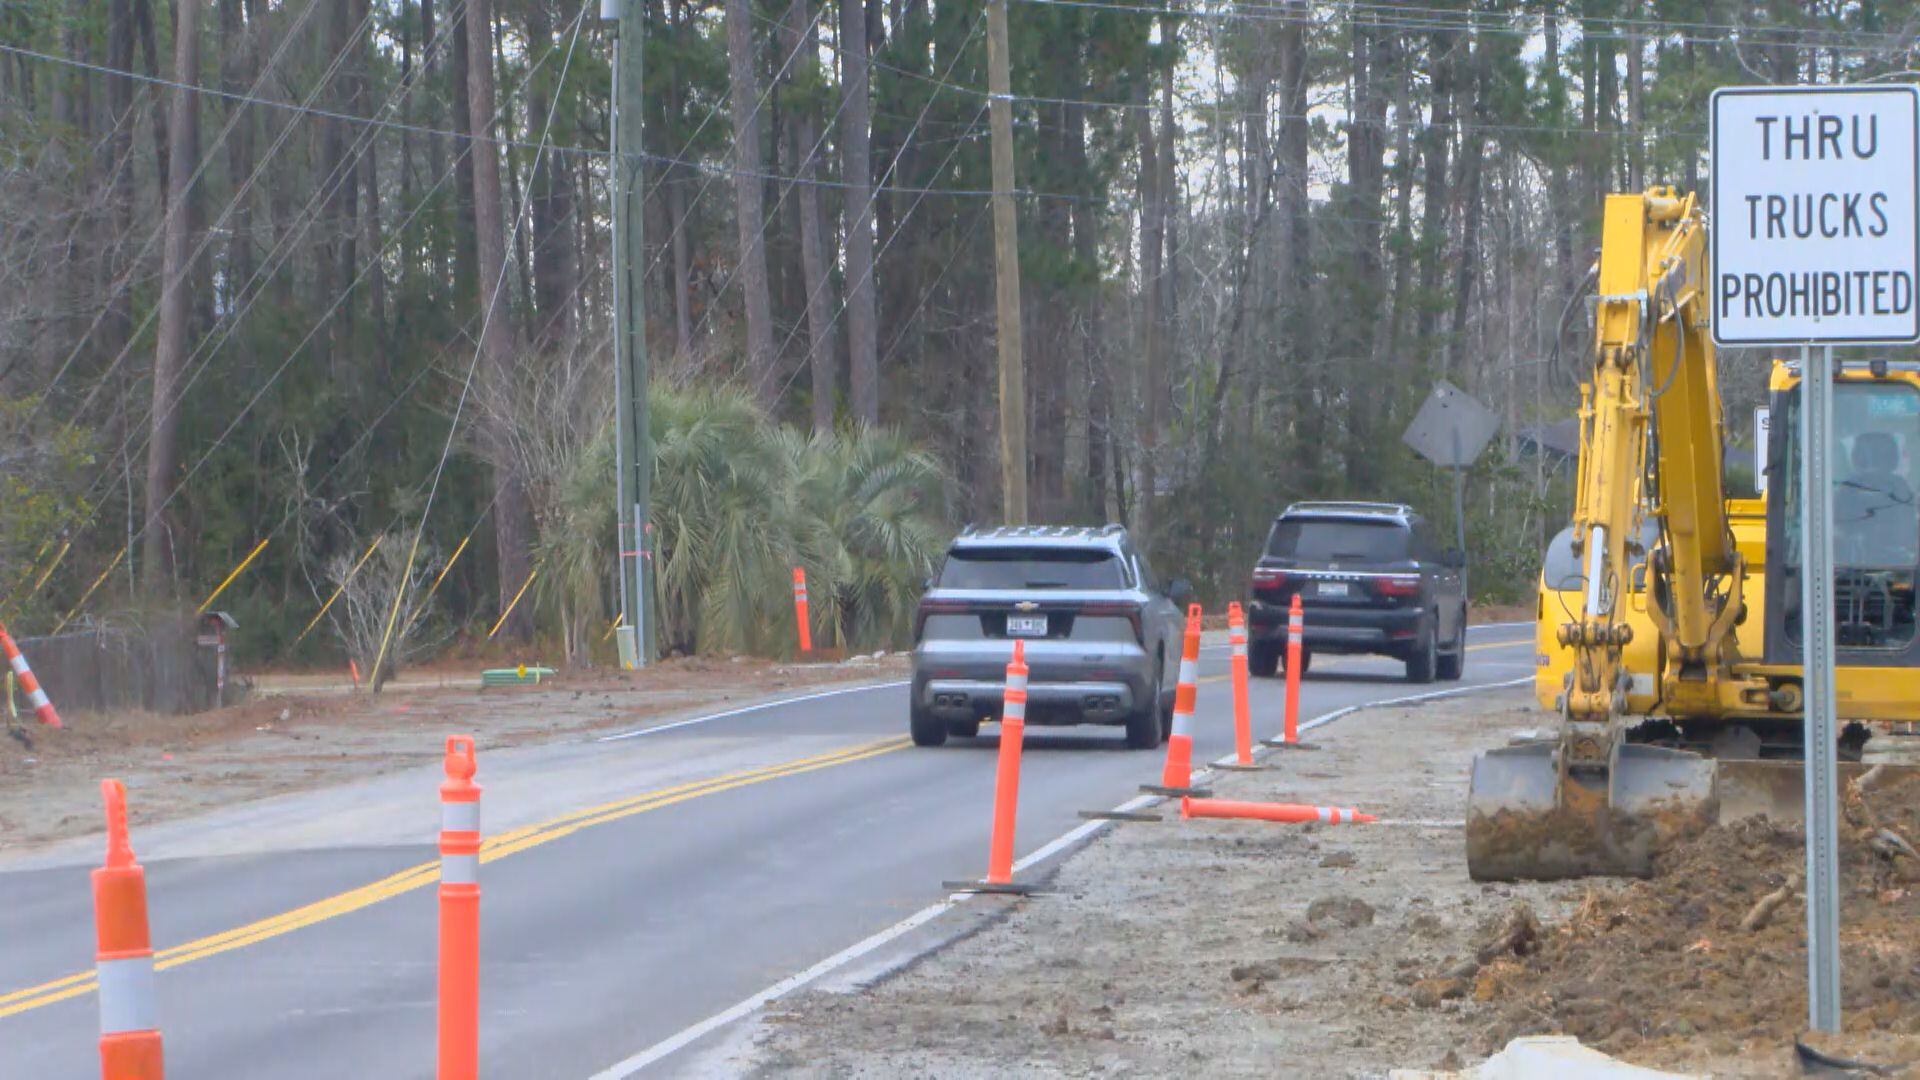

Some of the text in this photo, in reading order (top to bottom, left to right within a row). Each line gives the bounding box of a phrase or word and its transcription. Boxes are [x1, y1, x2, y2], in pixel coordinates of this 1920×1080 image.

[1755, 114, 1877, 160] THRU
[1745, 191, 1888, 239] TRUCKS
[1721, 270, 1912, 318] PROHIBITED
